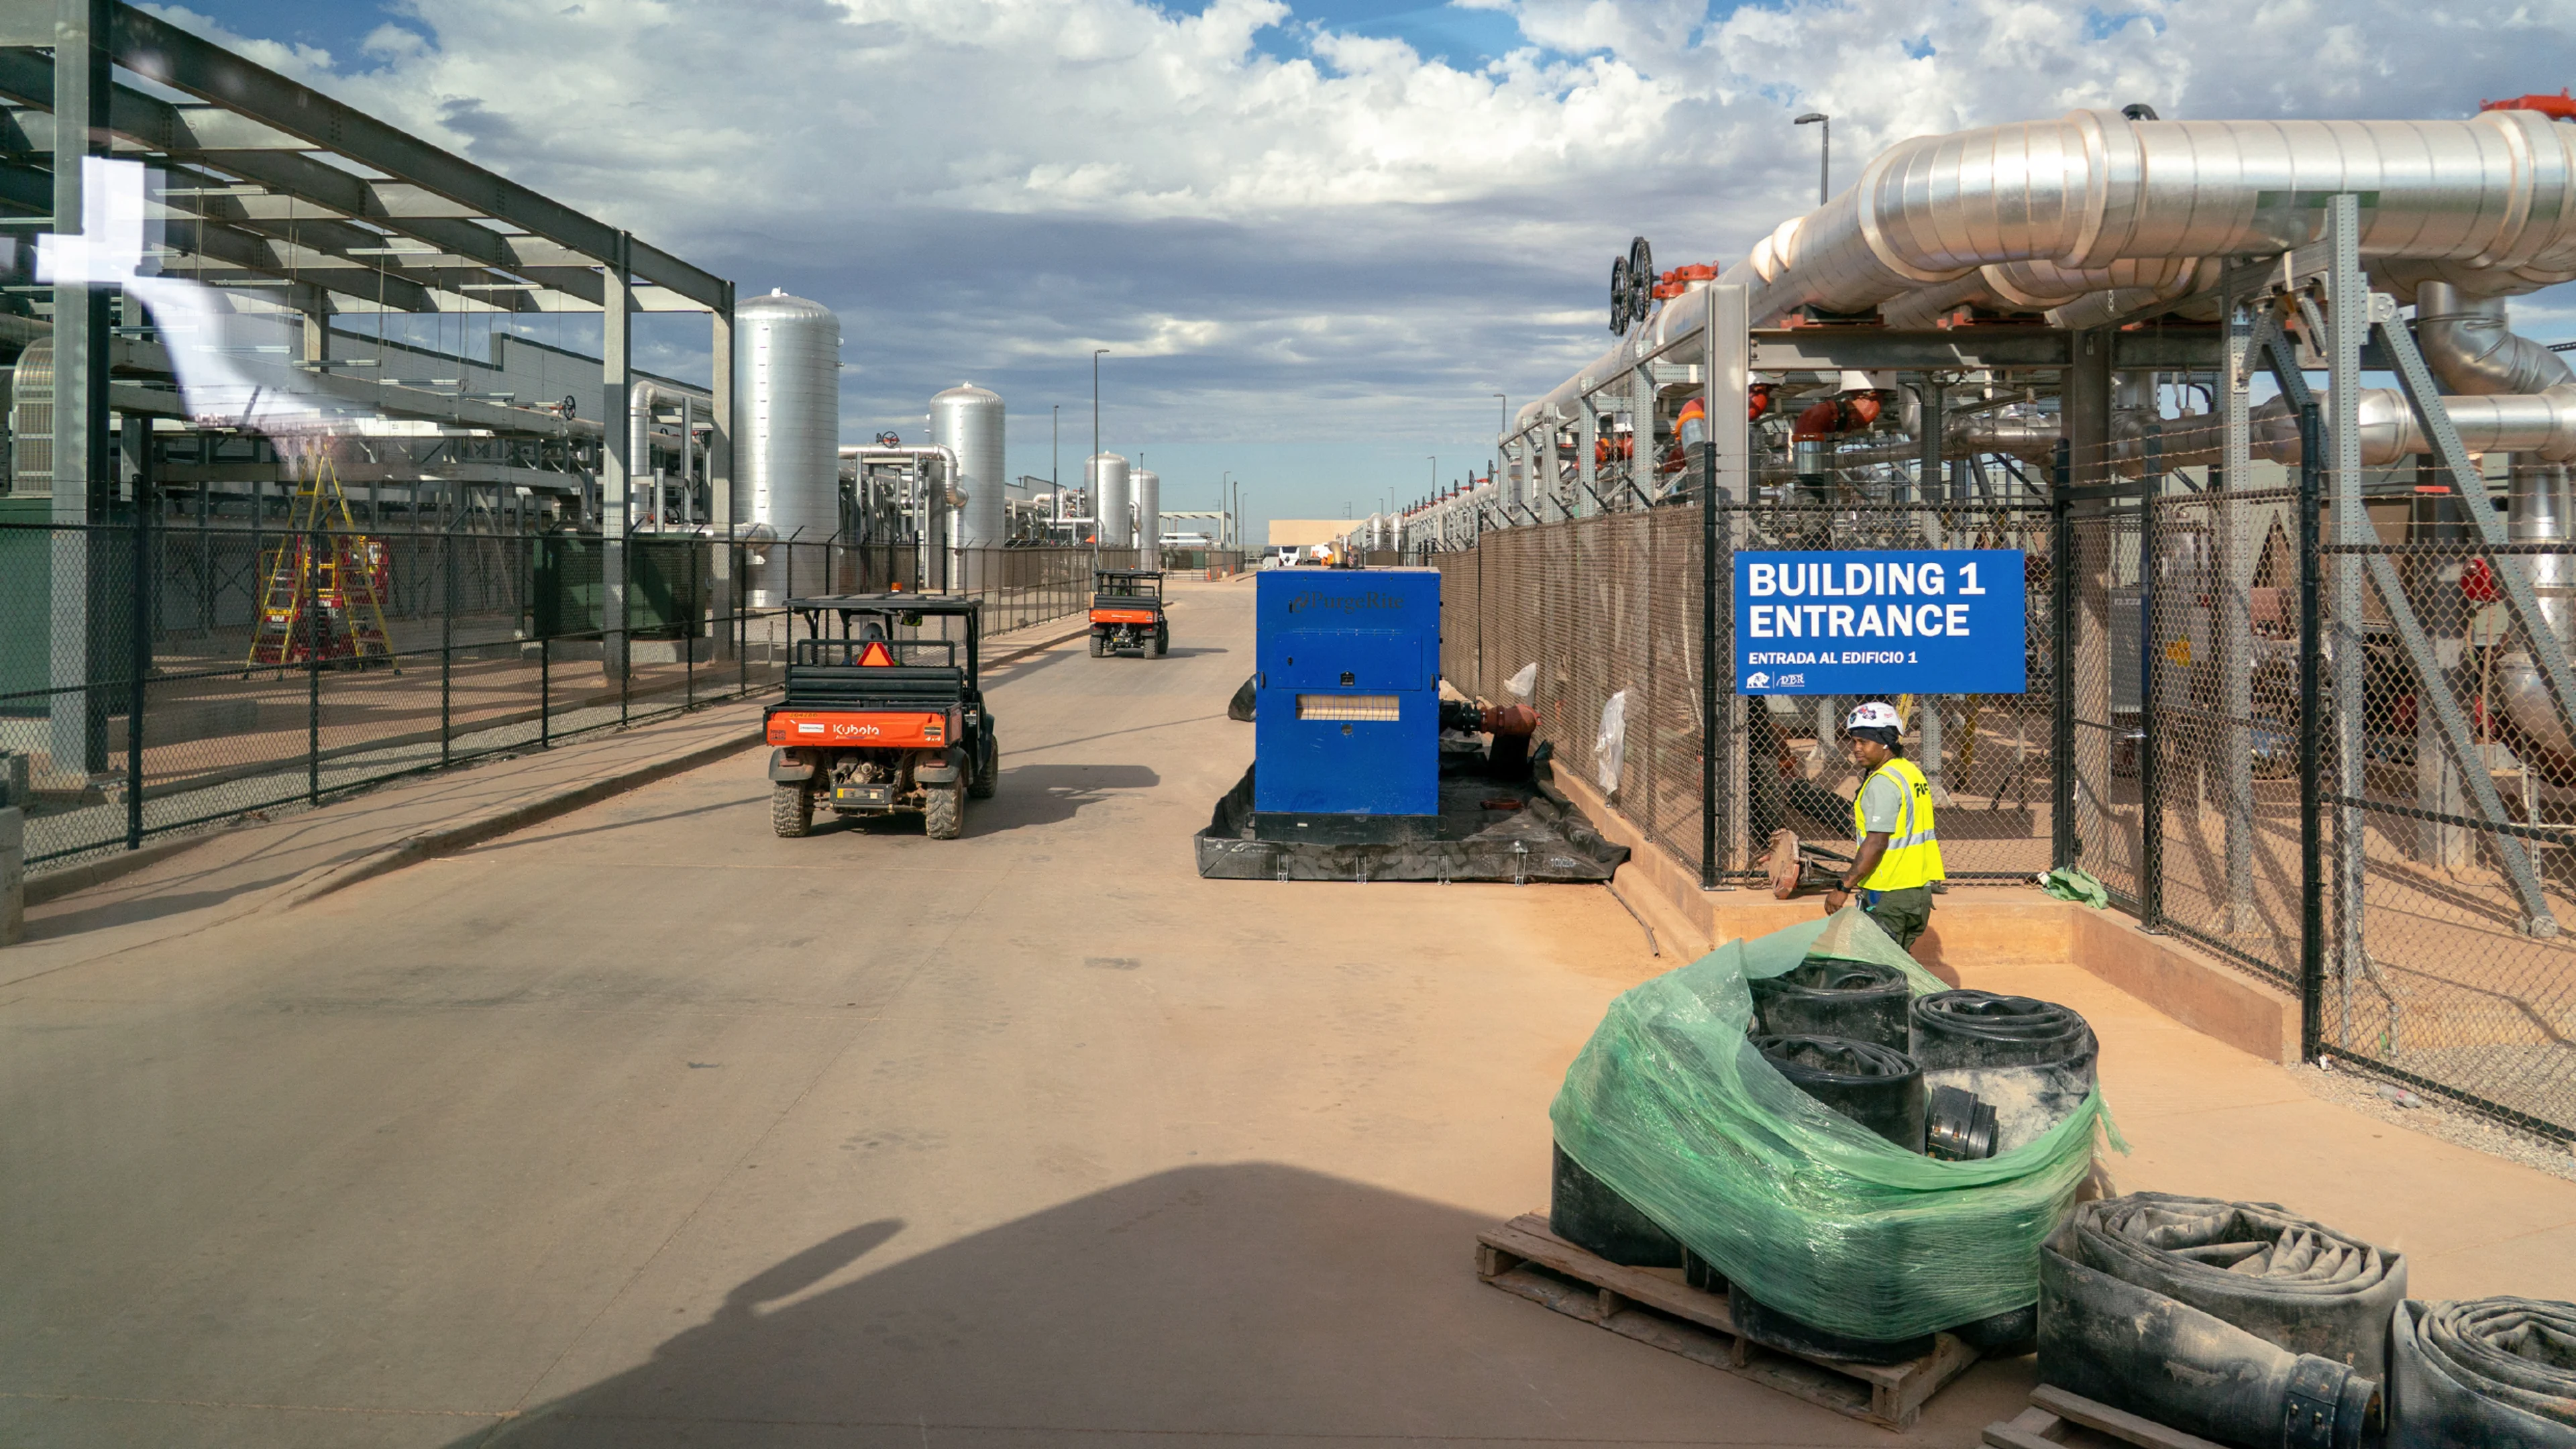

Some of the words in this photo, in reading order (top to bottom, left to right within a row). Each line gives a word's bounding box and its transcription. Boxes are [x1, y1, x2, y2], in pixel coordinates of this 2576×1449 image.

[1749, 563, 1945, 596] BUILDING
[1959, 562, 1986, 595] 1
[1311, 591, 1404, 614] PurgeRite
[1750, 604, 1970, 637] ENTRANCE
[1748, 652, 1817, 665] ENTRADA
[1819, 652, 1838, 664] AL
[1841, 651, 1904, 664] EDIFICIO
[1908, 651, 1918, 663] 1
[1780, 674, 1805, 684] DPR
[833, 724, 879, 735] Kubota
